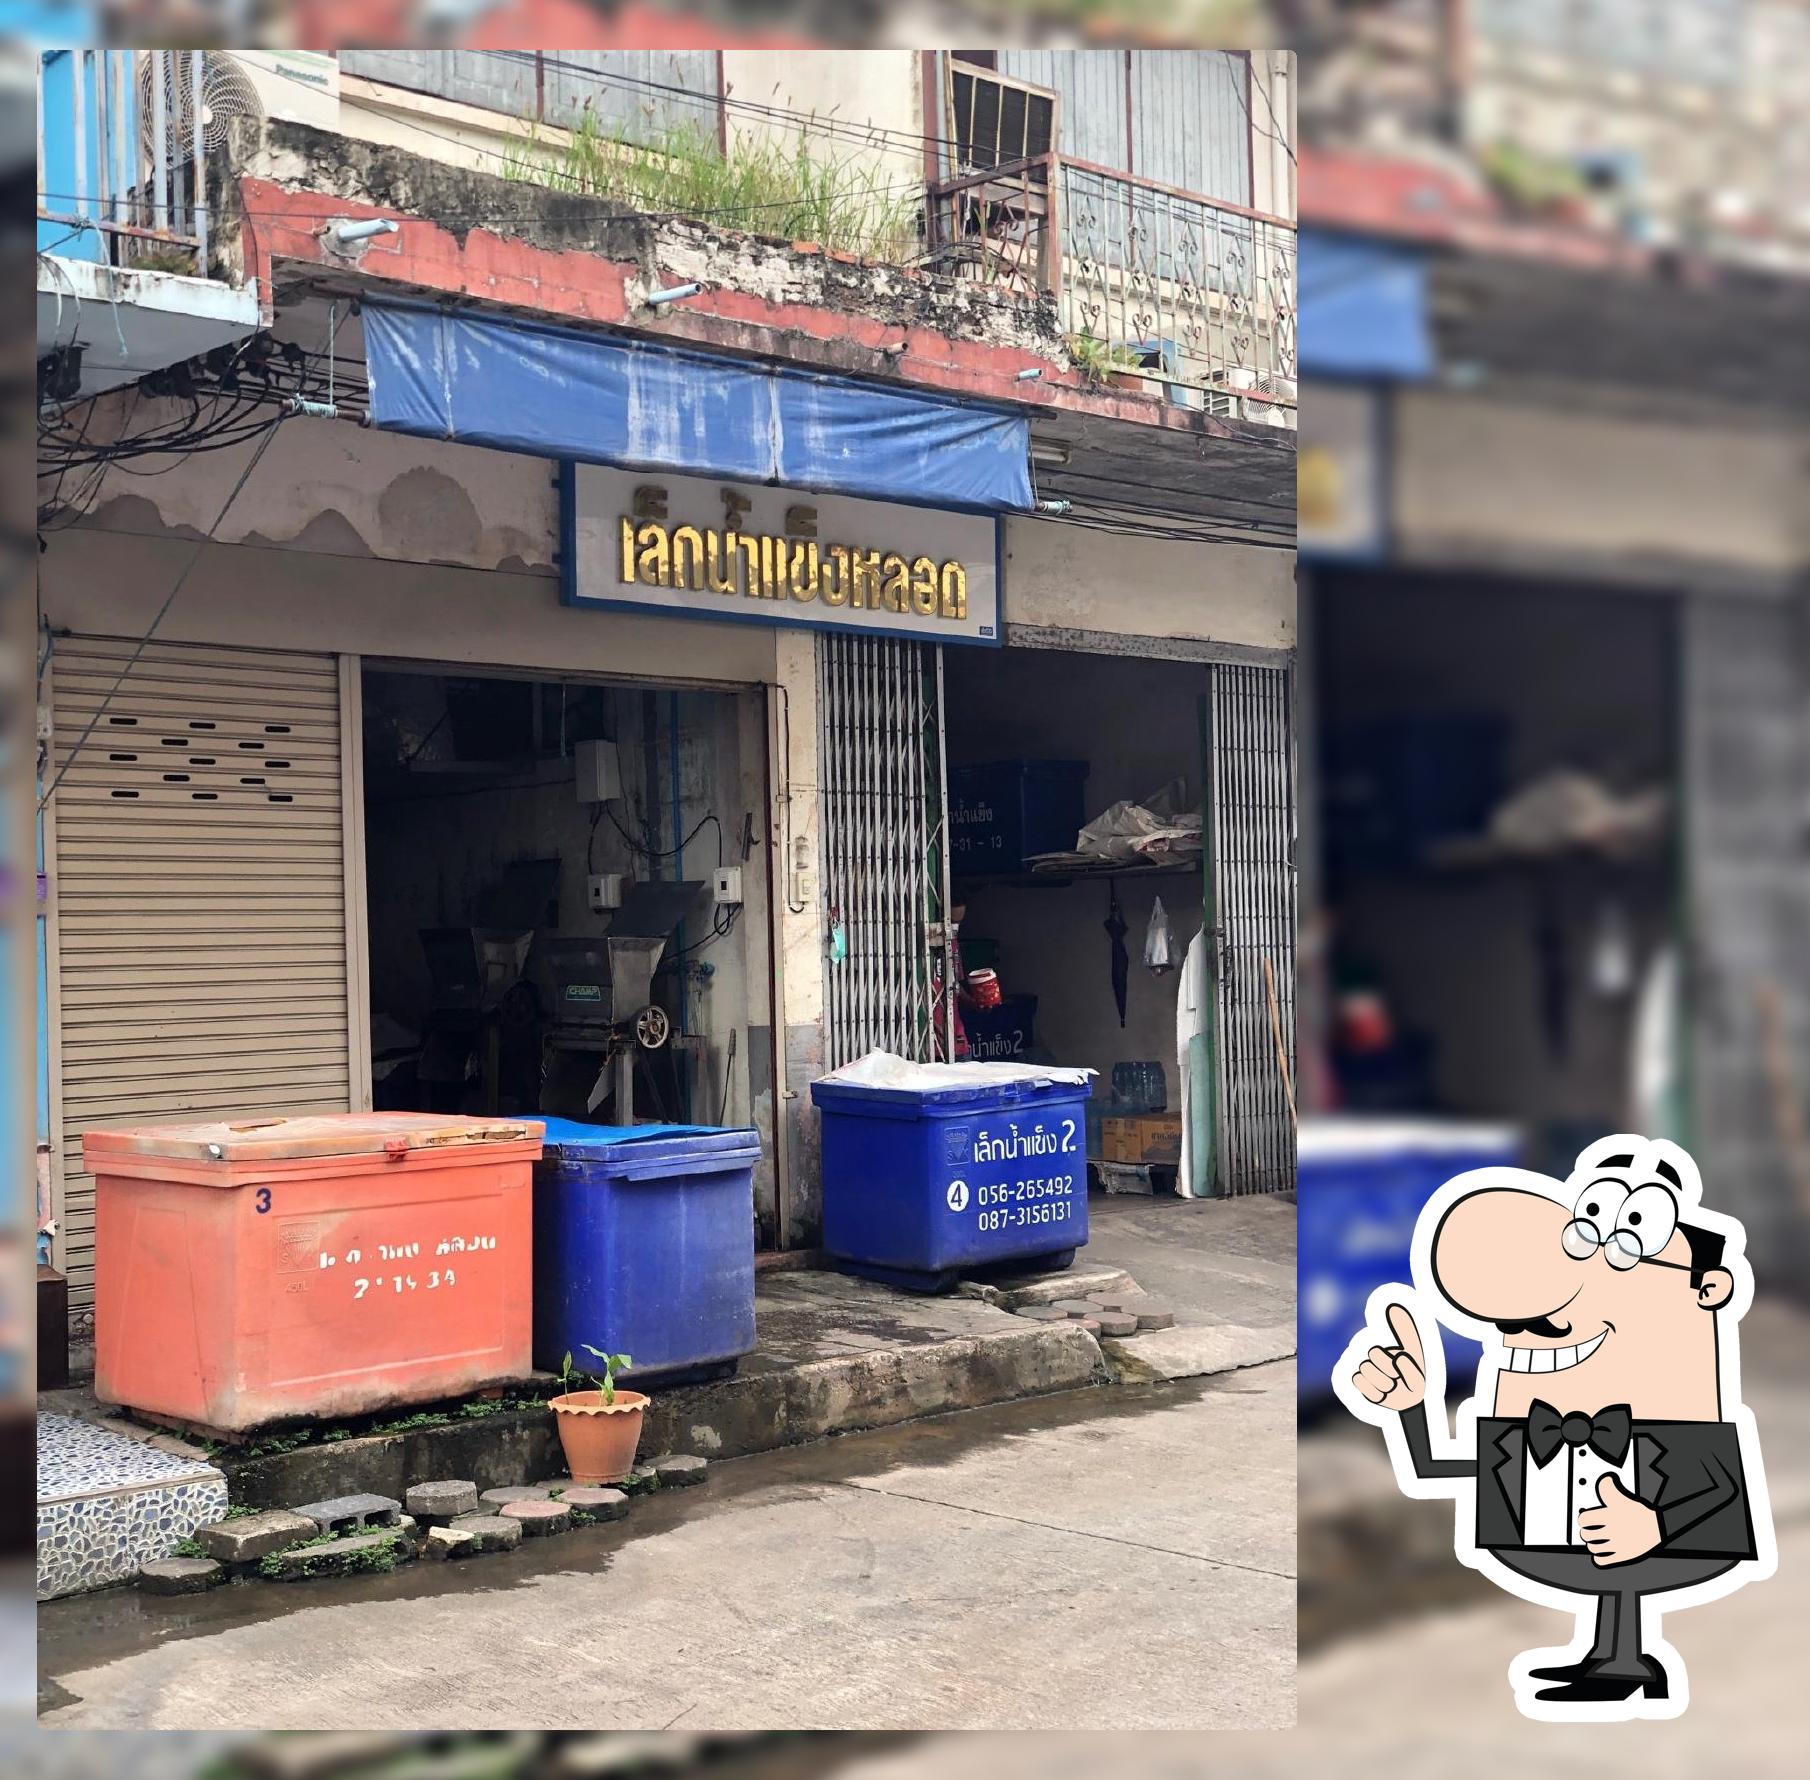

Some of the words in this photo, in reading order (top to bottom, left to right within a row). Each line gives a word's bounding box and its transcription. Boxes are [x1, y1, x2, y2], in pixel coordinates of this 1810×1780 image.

[276, 64, 329, 86] Panasonic
[619, 484, 967, 620] เล็กน้ำแข็งหลอด
[255, 1187, 272, 1214] 3
[950, 1183, 963, 1207] 4
[978, 1175, 1073, 1206] 056-265492
[978, 1201, 1071, 1231] 087-3156131
